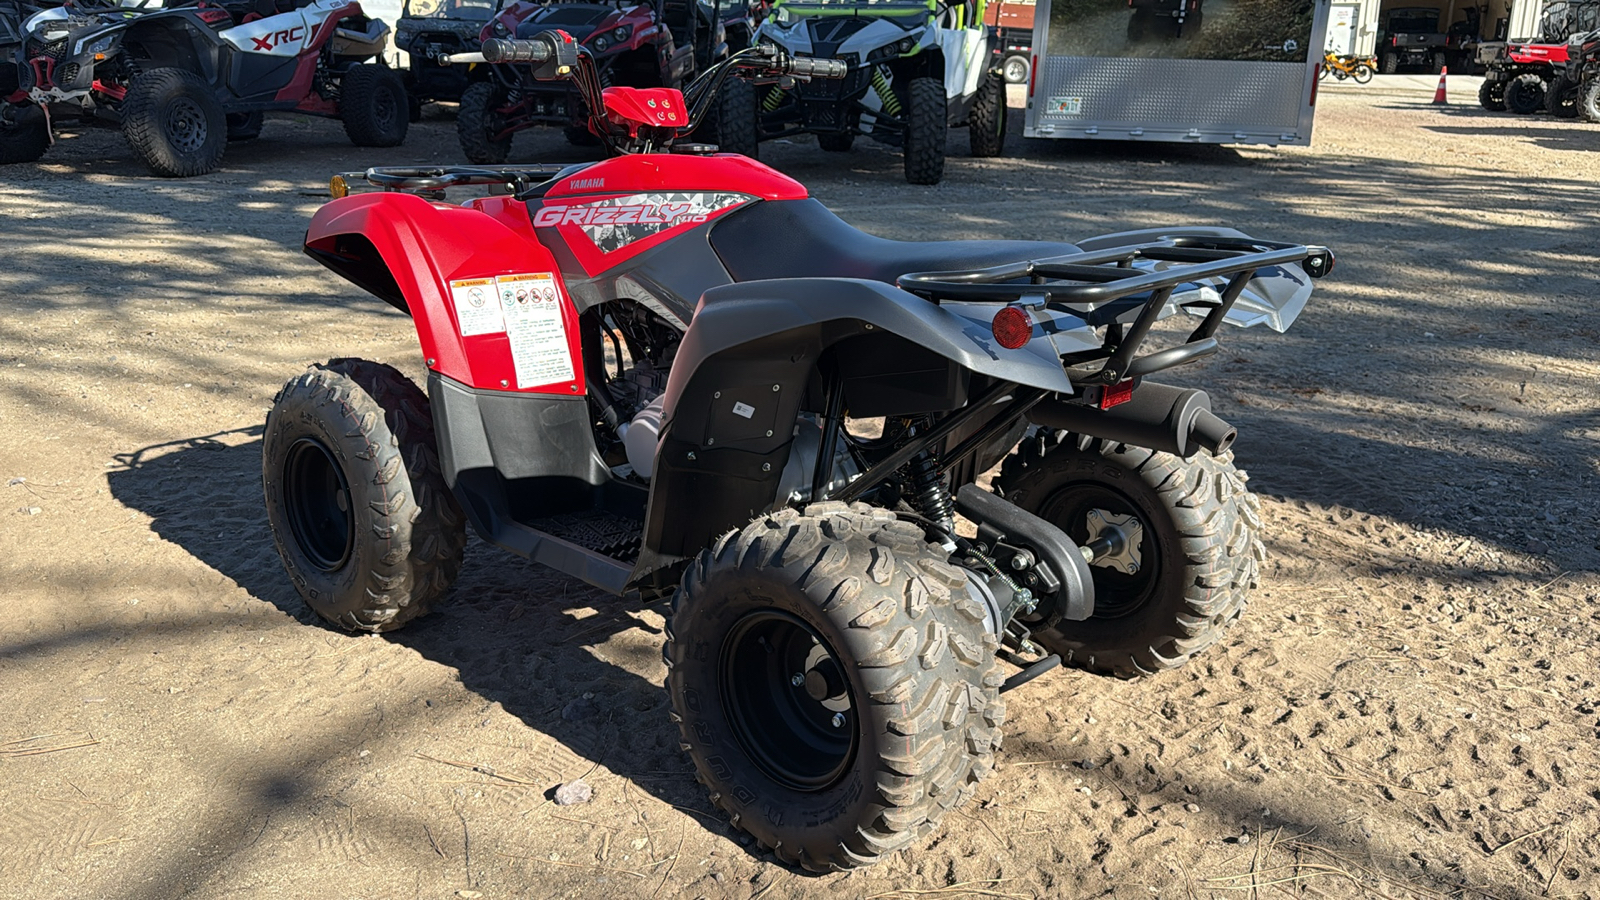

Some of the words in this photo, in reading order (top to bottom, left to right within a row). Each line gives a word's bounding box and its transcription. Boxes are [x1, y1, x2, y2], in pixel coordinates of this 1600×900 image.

[570, 178, 605, 190] YAMAHA
[533, 203, 690, 227] GRIZZLY
[683, 688, 757, 807] DURO
